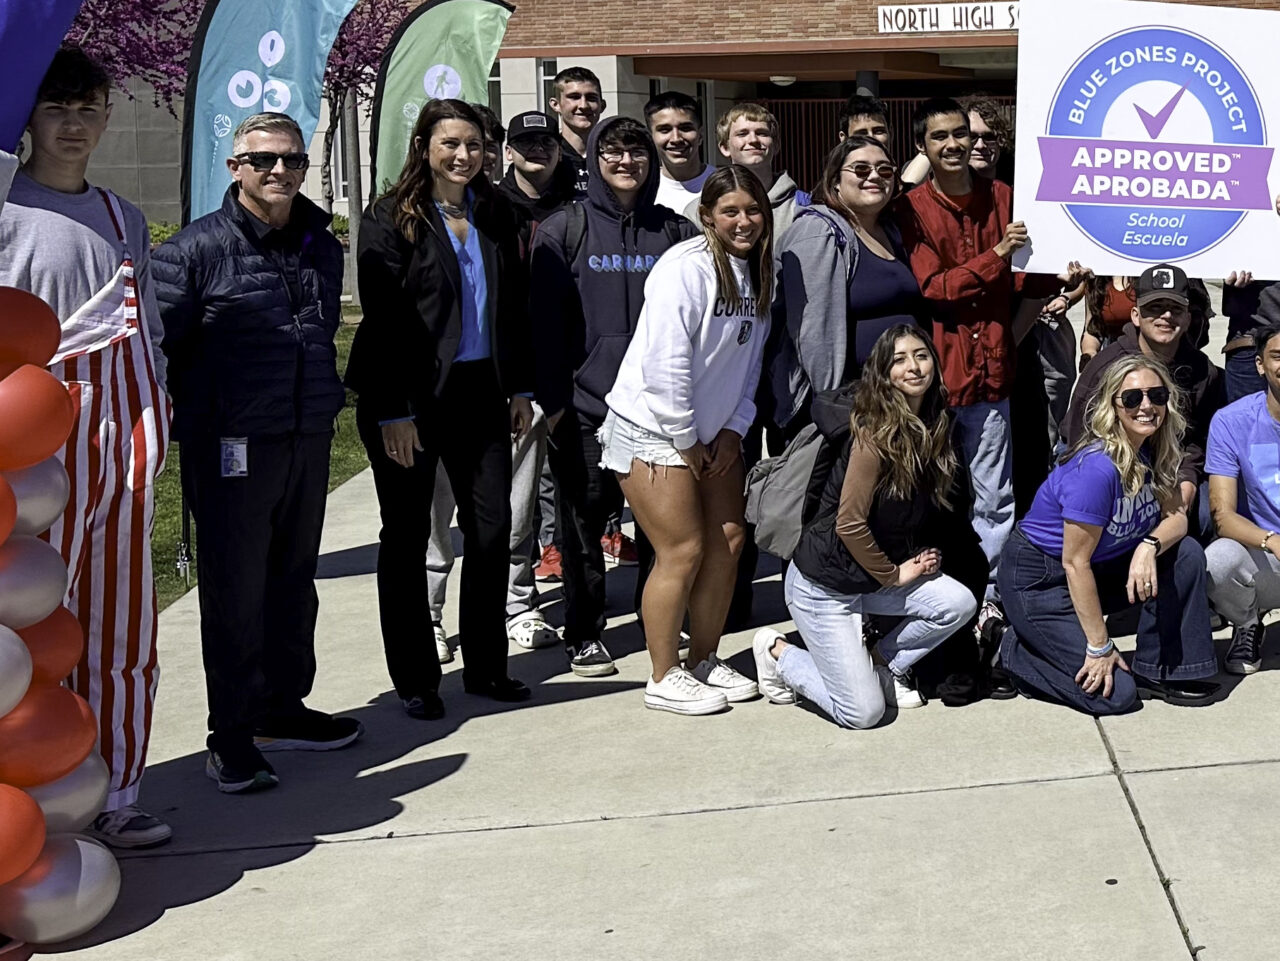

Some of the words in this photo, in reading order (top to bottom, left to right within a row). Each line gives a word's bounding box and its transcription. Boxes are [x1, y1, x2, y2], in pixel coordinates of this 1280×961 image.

[882, 7, 939, 32] NORTH
[953, 5, 994, 30] HIGH
[1008, 4, 1019, 29] S
[1068, 68, 1108, 125] BLUE
[1105, 45, 1177, 76] ZONES
[1180, 52, 1247, 133] PROJECT
[1127, 213, 1186, 229] School
[1122, 231, 1189, 247] Escuela
[1135, 484, 1155, 510] M
[1137, 500, 1160, 523] ZON
